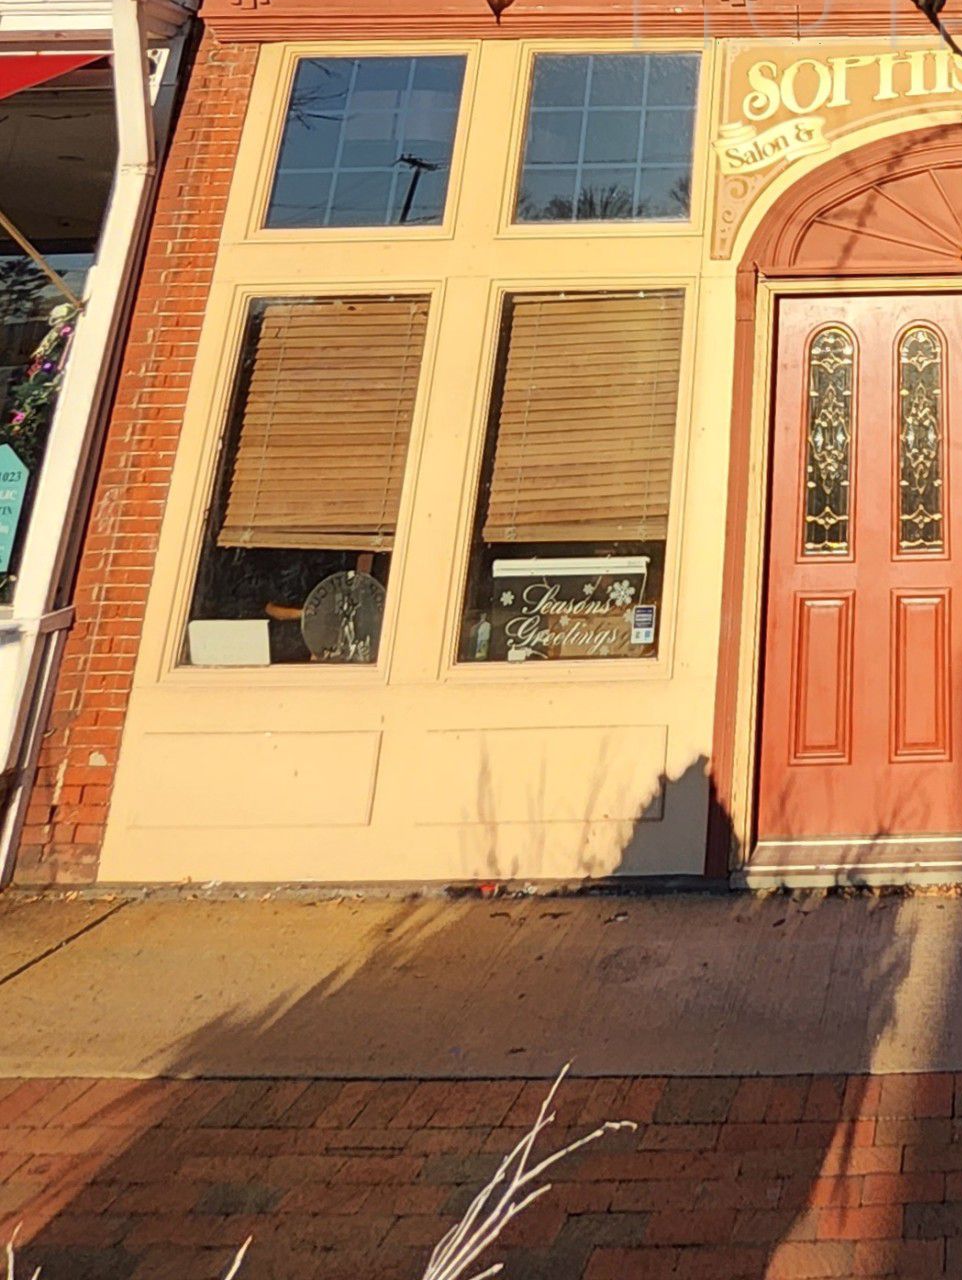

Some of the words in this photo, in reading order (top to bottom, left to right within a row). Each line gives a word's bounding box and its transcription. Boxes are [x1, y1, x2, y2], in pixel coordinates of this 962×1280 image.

[725, 136, 789, 168] Salon
[795, 123, 814, 142] &
[522, 584, 611, 615] Seasons
[505, 615, 618, 654] Greetings
